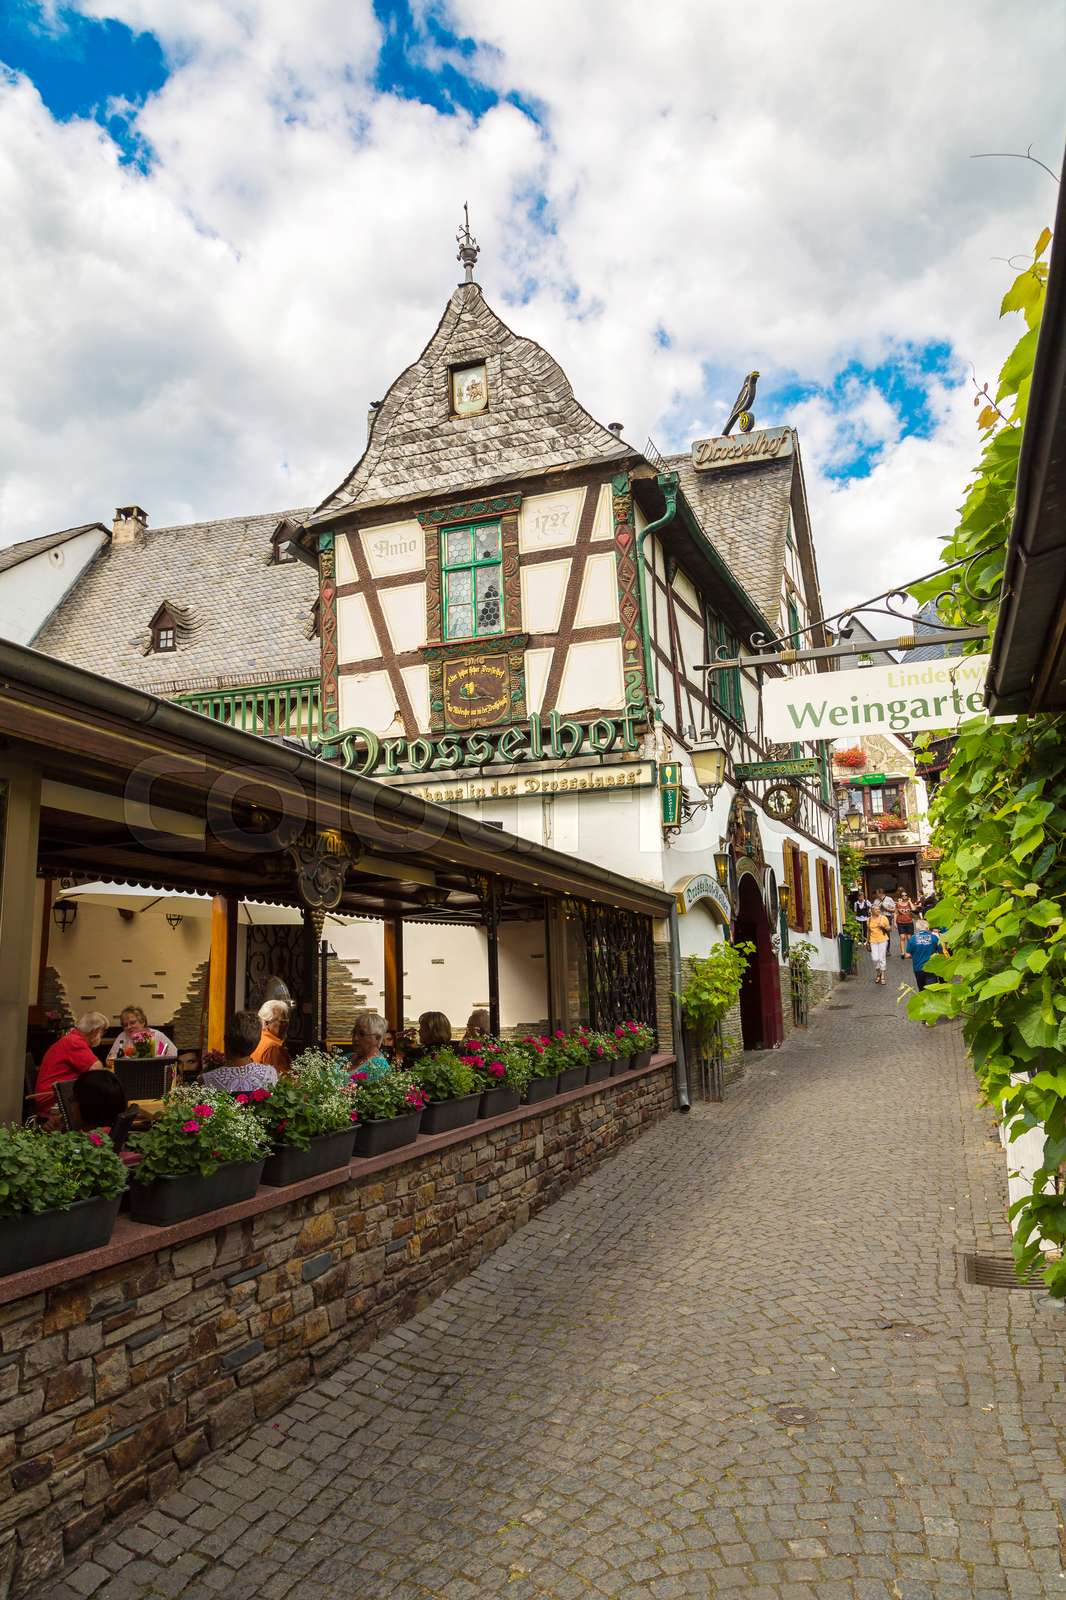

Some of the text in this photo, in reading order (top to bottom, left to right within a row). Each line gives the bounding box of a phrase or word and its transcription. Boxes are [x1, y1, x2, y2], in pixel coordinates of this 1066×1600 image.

[696, 428, 791, 465] Drosselhof
[372, 539, 418, 558] Anno
[887, 660, 988, 688] Lindenwi
[786, 688, 986, 730] Weingarte
[318, 702, 647, 775] Drosselhof
[490, 780, 518, 797] der
